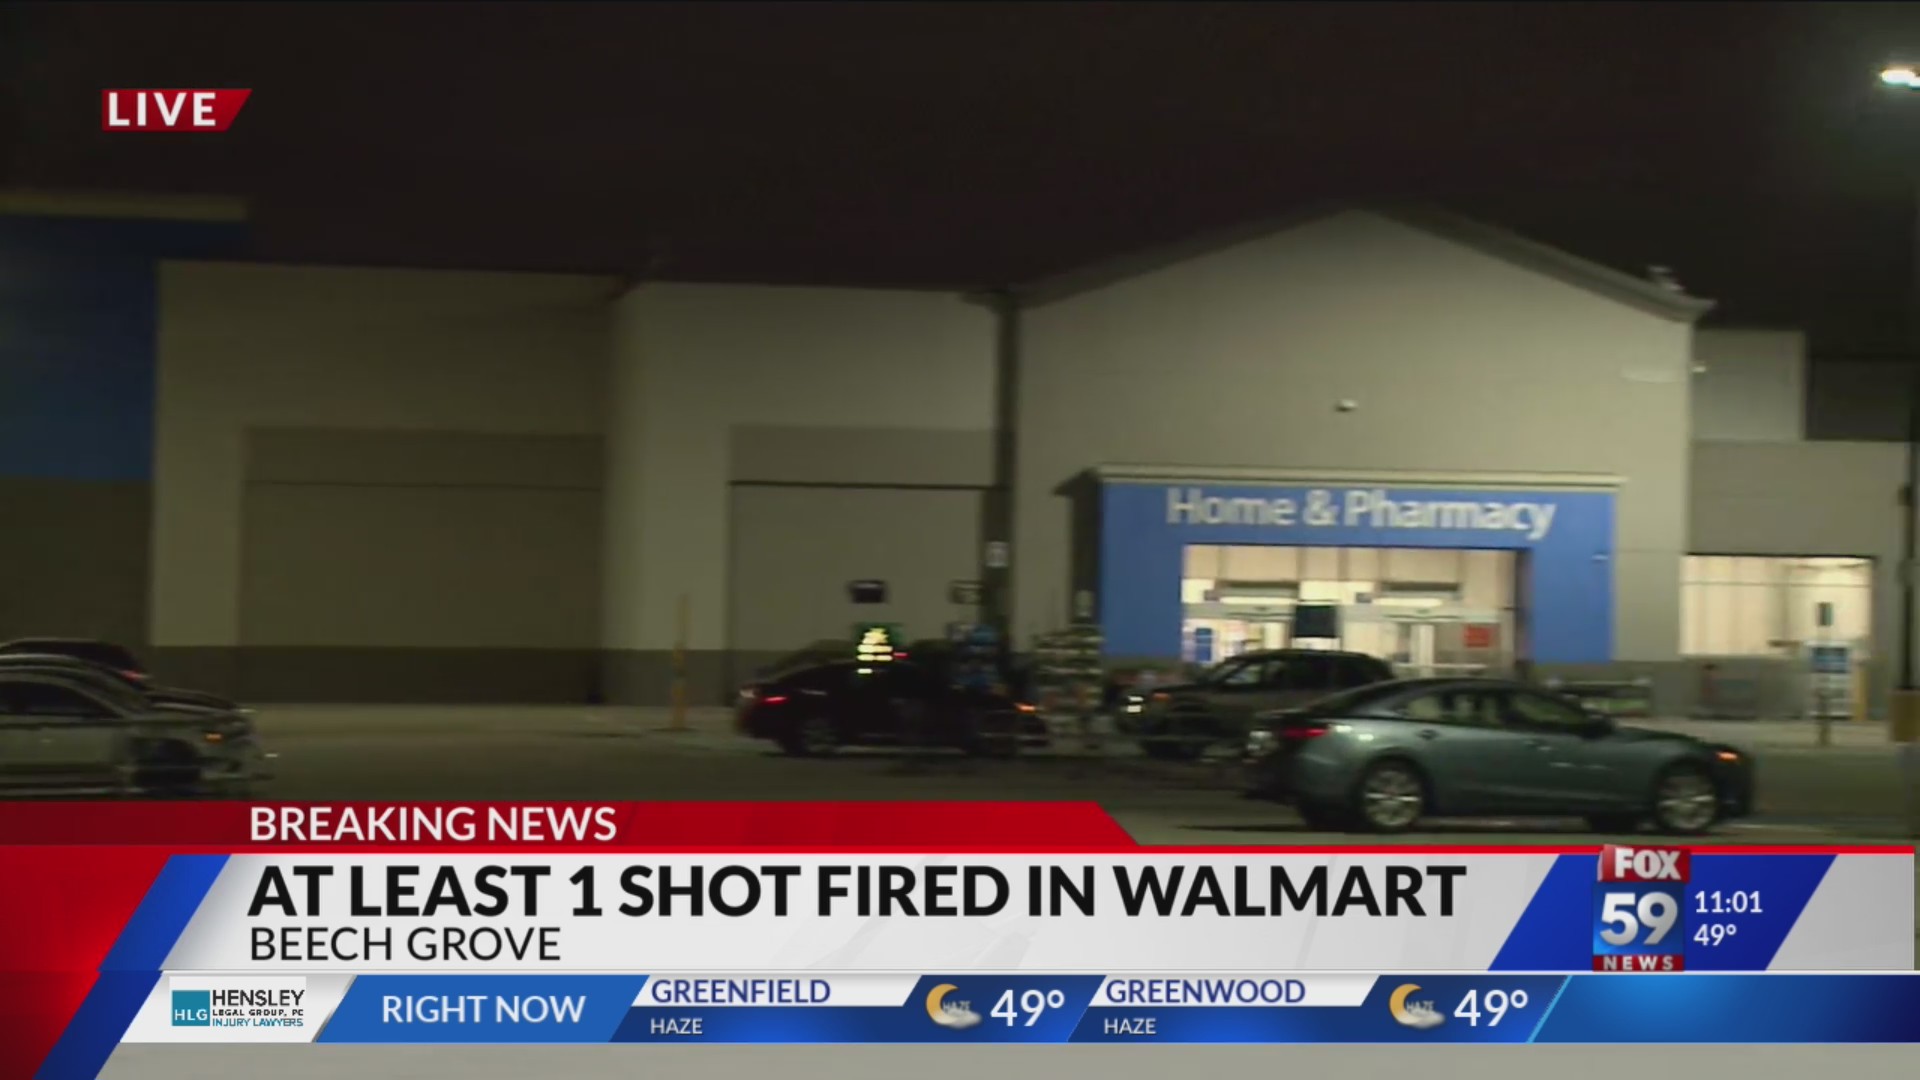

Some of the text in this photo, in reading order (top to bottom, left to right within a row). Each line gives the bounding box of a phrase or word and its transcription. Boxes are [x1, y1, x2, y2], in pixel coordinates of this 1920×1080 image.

[1166, 488, 1556, 540] Home & Pharmacy
